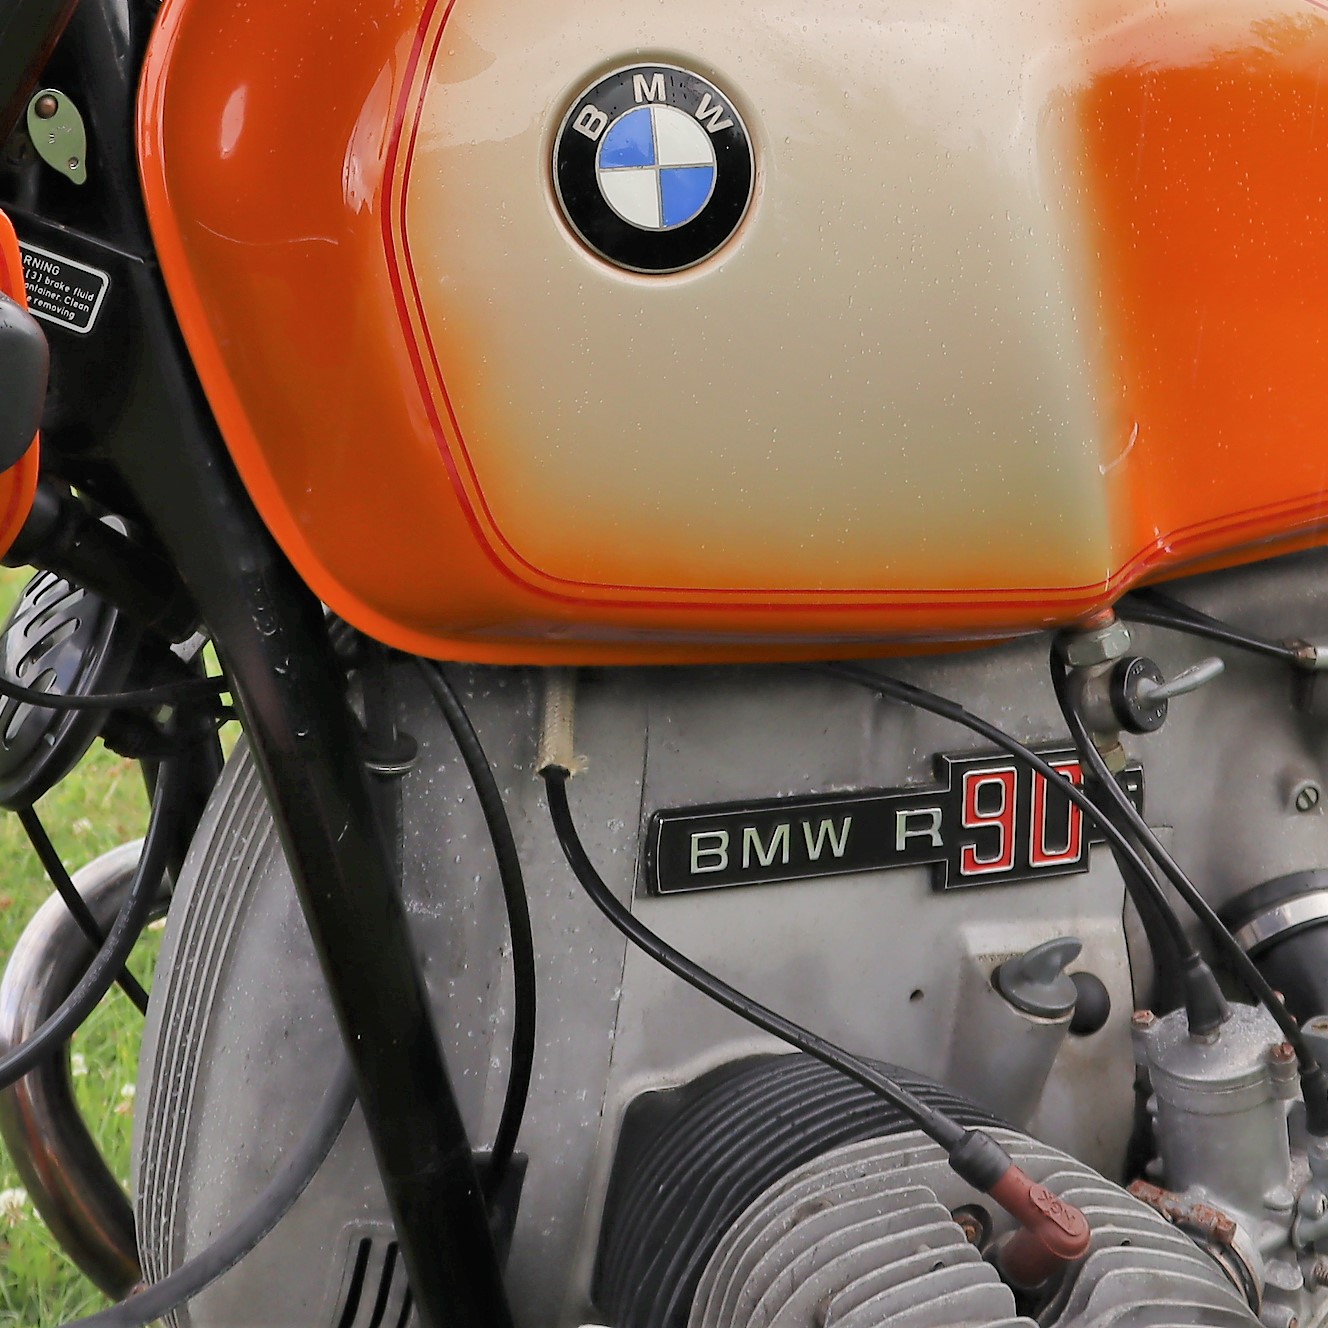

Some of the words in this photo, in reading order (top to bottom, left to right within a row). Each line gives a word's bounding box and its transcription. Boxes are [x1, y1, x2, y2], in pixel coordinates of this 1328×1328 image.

[572, 73, 735, 142] BMW
[21, 253, 60, 276] RNING
[24, 282, 62, 302] ontainer.
[63, 296, 90, 313] Clean
[44, 276, 71, 293] brake
[73, 287, 95, 302] fluid
[33, 298, 75, 321] removing
[690, 816, 853, 874] BMW
